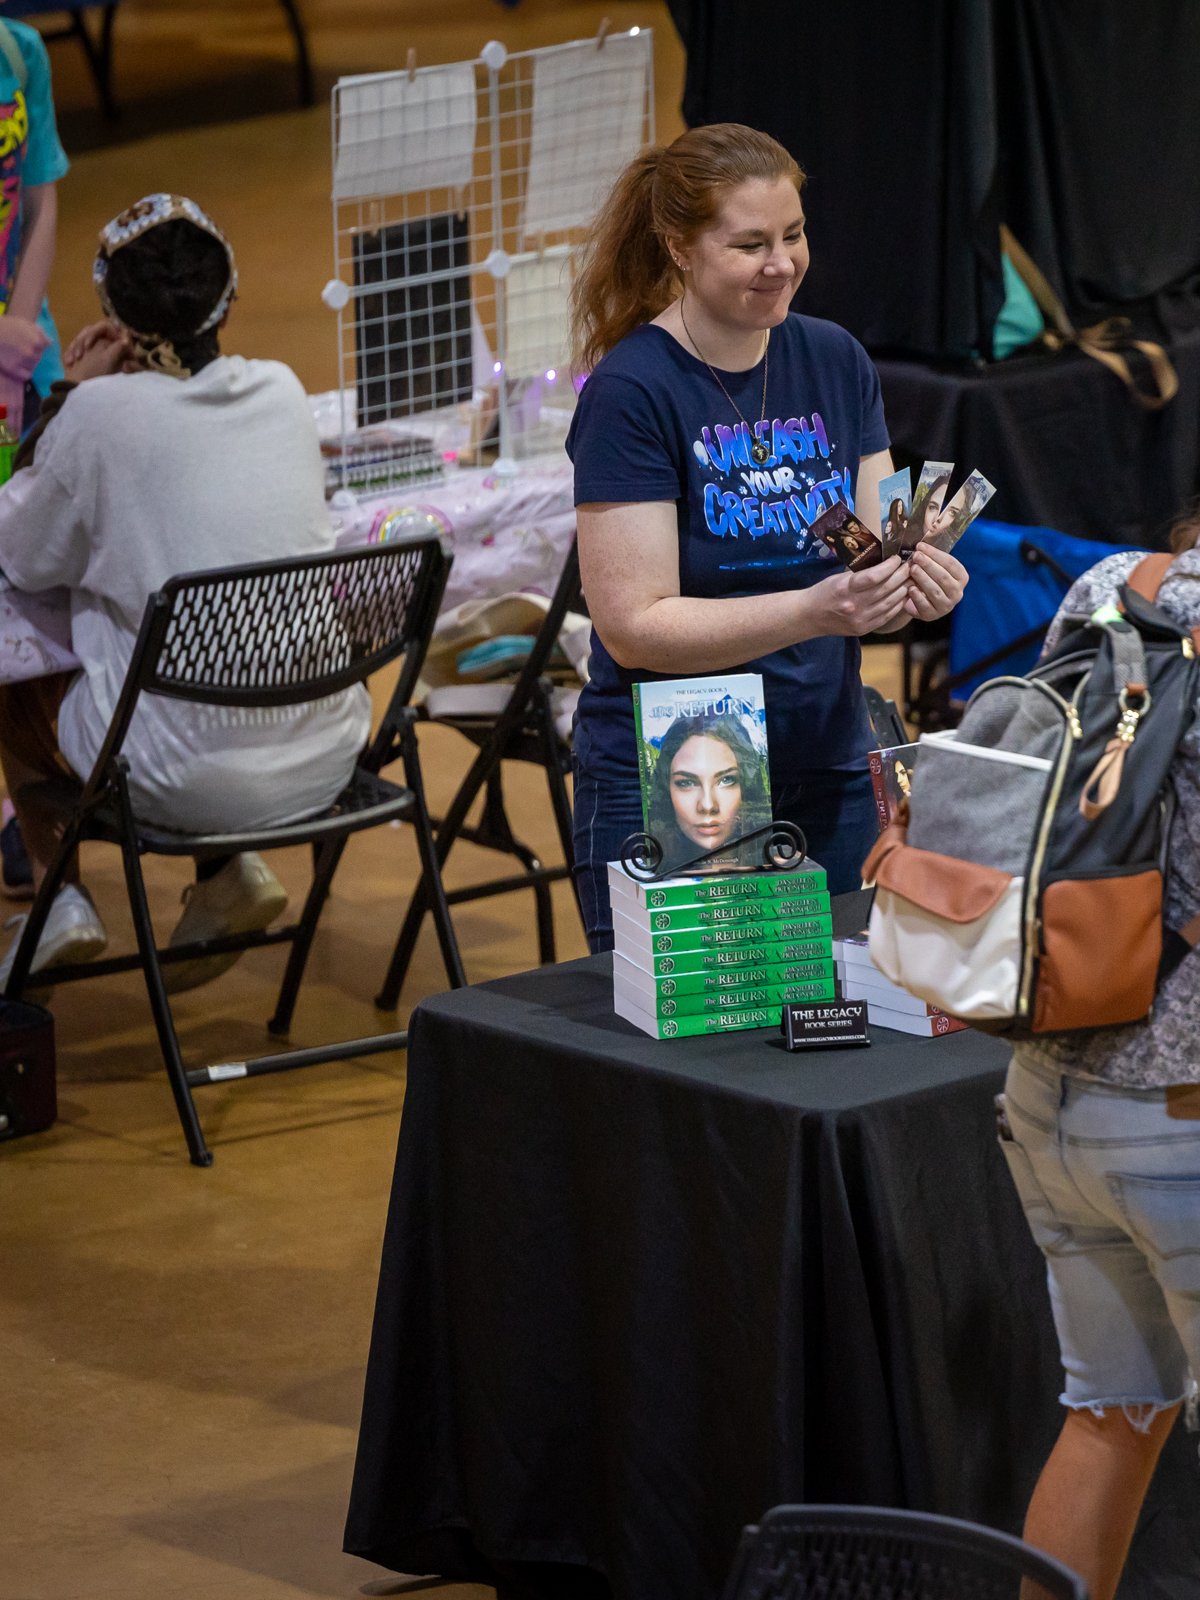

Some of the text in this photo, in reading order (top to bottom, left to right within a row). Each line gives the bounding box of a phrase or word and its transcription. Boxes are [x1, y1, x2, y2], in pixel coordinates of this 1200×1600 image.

[702, 412, 830, 473] UNLEASH
[740, 466, 802, 496] YOUR
[675, 696, 756, 719] RETURN
[695, 882, 759, 897] The RETURN
[699, 904, 763, 919] The RETURN
[715, 926, 764, 942] RETURN
[717, 948, 766, 963] RETURN
[718, 970, 767, 985] RETURN
[719, 990, 768, 1005] RETURN
[719, 1010, 768, 1026] RETURN
[792, 1007, 862, 1021] THE LEGACY
[804, 1019, 852, 1029] BOOK SERIES
